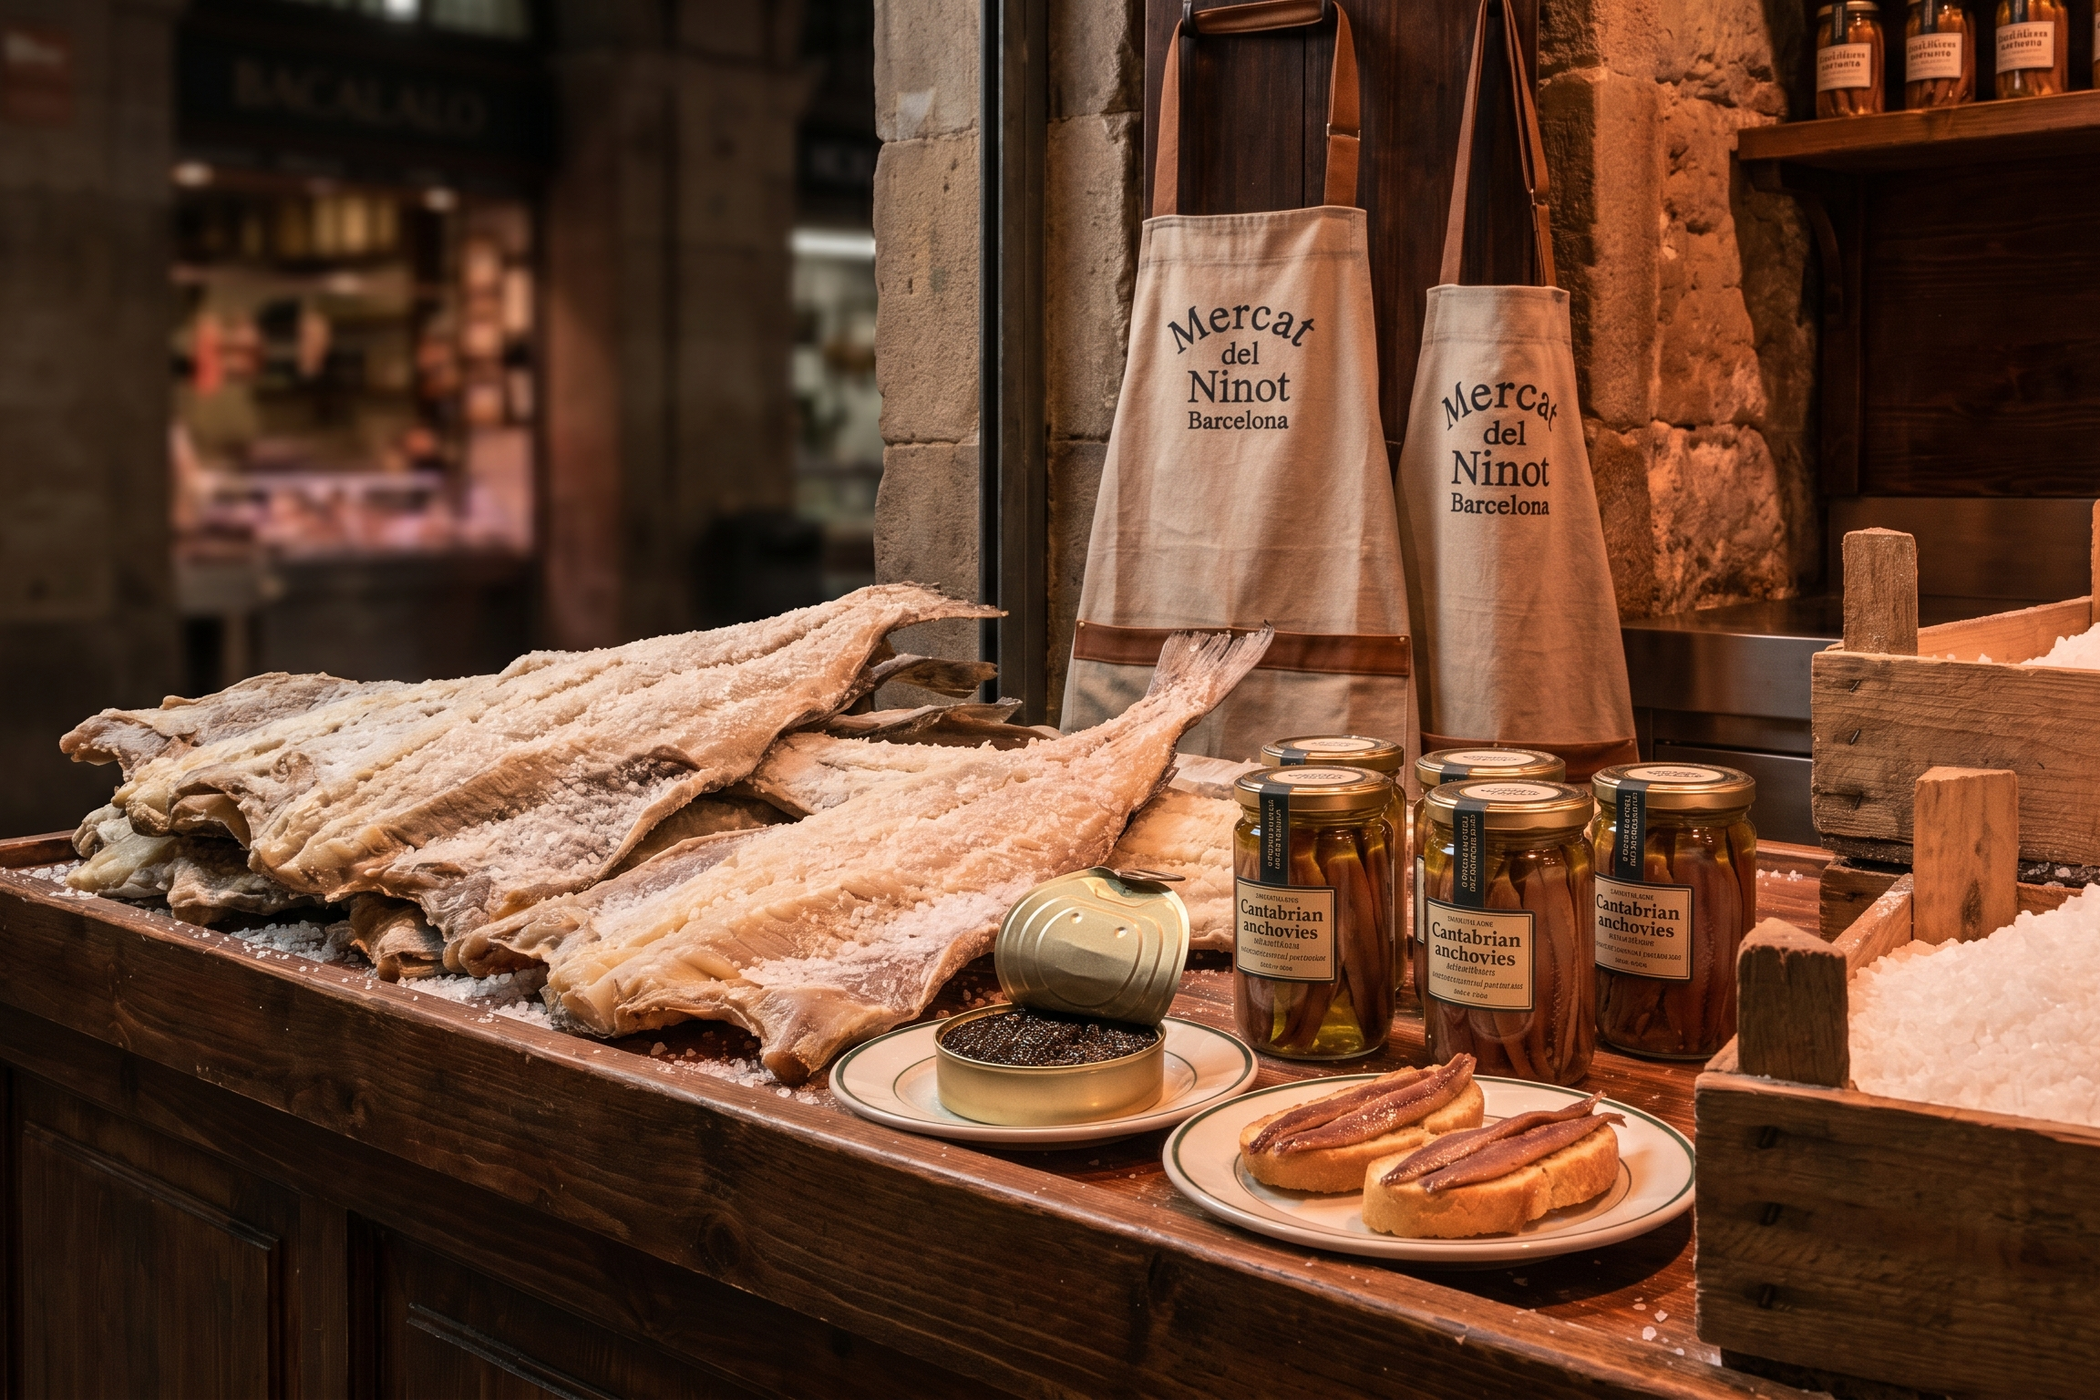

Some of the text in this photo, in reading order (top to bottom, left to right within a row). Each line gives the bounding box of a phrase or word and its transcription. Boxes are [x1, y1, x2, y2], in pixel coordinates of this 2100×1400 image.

[1168, 304, 1315, 355] Mercat
[1220, 341, 1260, 365] del
[1187, 370, 1291, 404] Ninot
[1441, 381, 1558, 432] Mercat
[1188, 410, 1289, 430] Barcelona
[1483, 421, 1527, 446] del
[1451, 449, 1550, 488] Ninot
[1450, 492, 1550, 516] Barcelona
[1240, 898, 1323, 922] Cantabrian
[1596, 894, 1681, 921] Cantabrian
[1243, 920, 1318, 940] anchovies
[1432, 921, 1521, 948] Cantabrian
[1598, 915, 1675, 938] anchovies
[1435, 944, 1516, 967] anchovies
